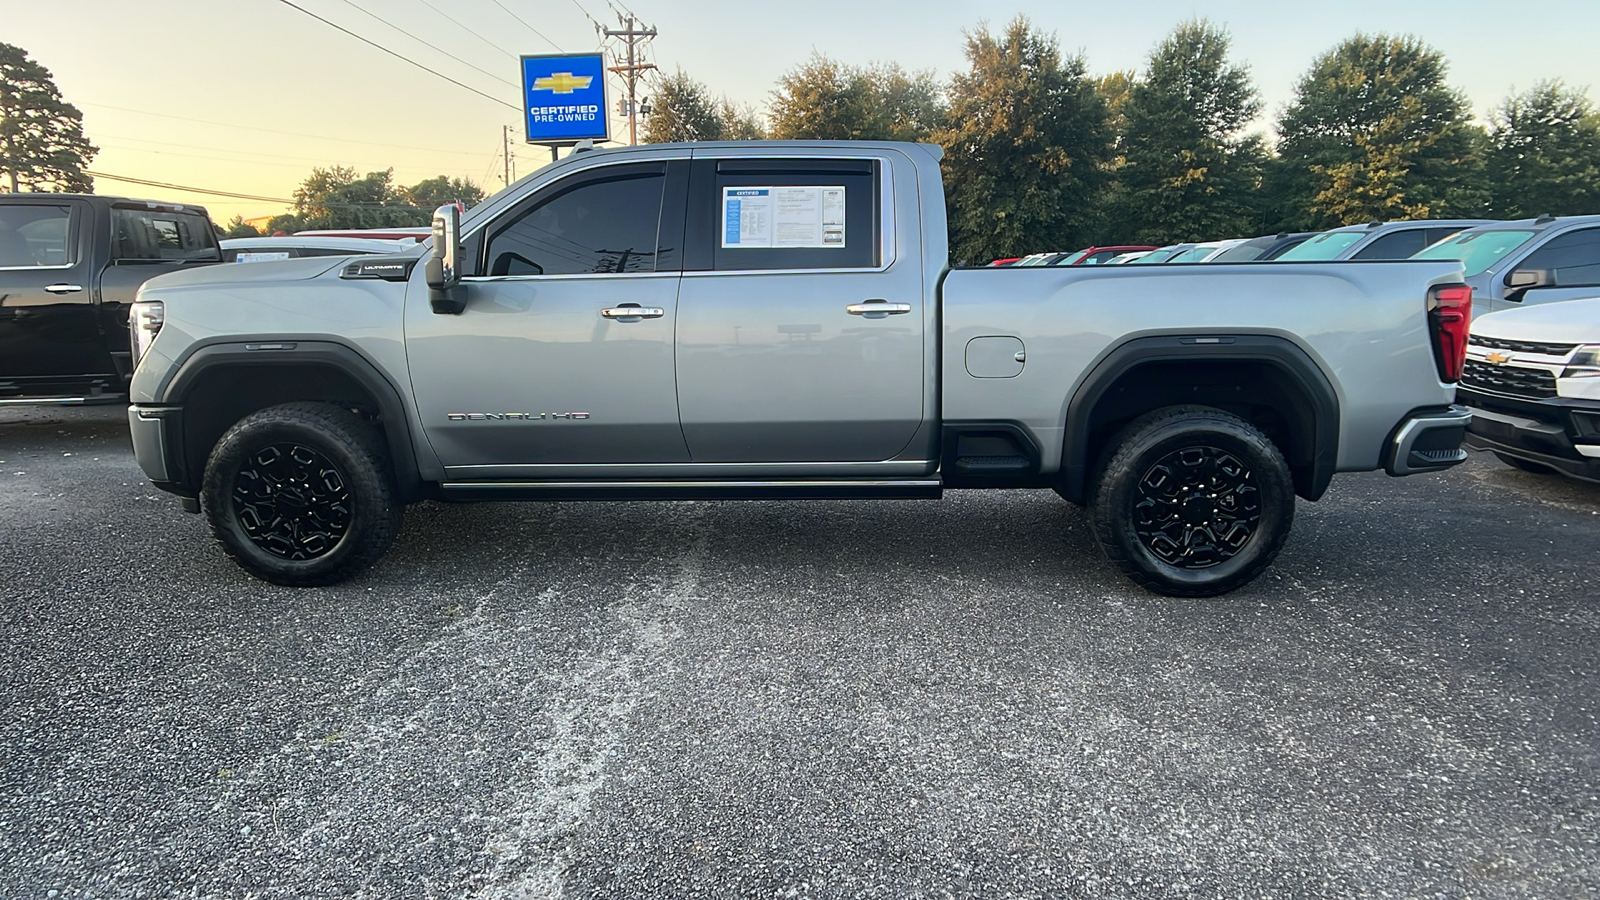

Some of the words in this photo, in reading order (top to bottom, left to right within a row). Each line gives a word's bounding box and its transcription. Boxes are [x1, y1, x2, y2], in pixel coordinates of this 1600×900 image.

[531, 105, 598, 115] CERTIFIED
[535, 114, 595, 122] PRE-OWNED
[448, 412, 546, 420] DENALI
